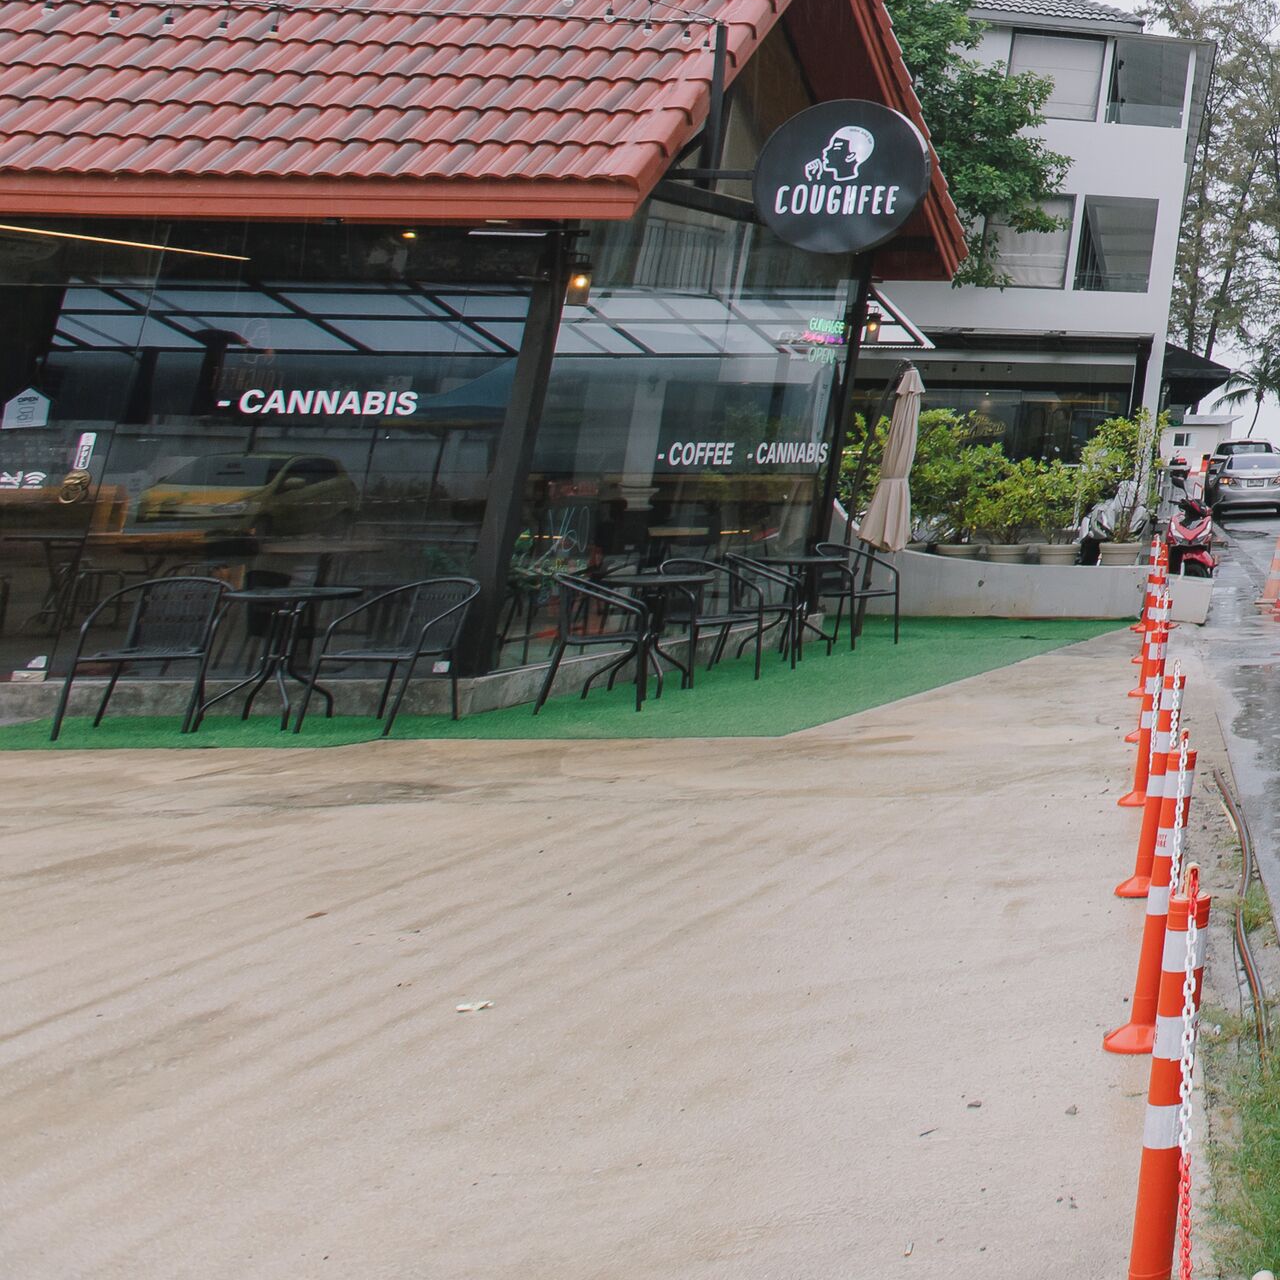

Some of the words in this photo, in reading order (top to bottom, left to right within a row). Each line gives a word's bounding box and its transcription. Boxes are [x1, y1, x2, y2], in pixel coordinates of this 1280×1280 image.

[774, 183, 899, 215] COUGHFEE
[807, 346, 836, 365] OPEN
[238, 389, 419, 416] CANNABIS
[668, 441, 735, 466] COFFEE
[756, 441, 829, 465] CANNABIS
